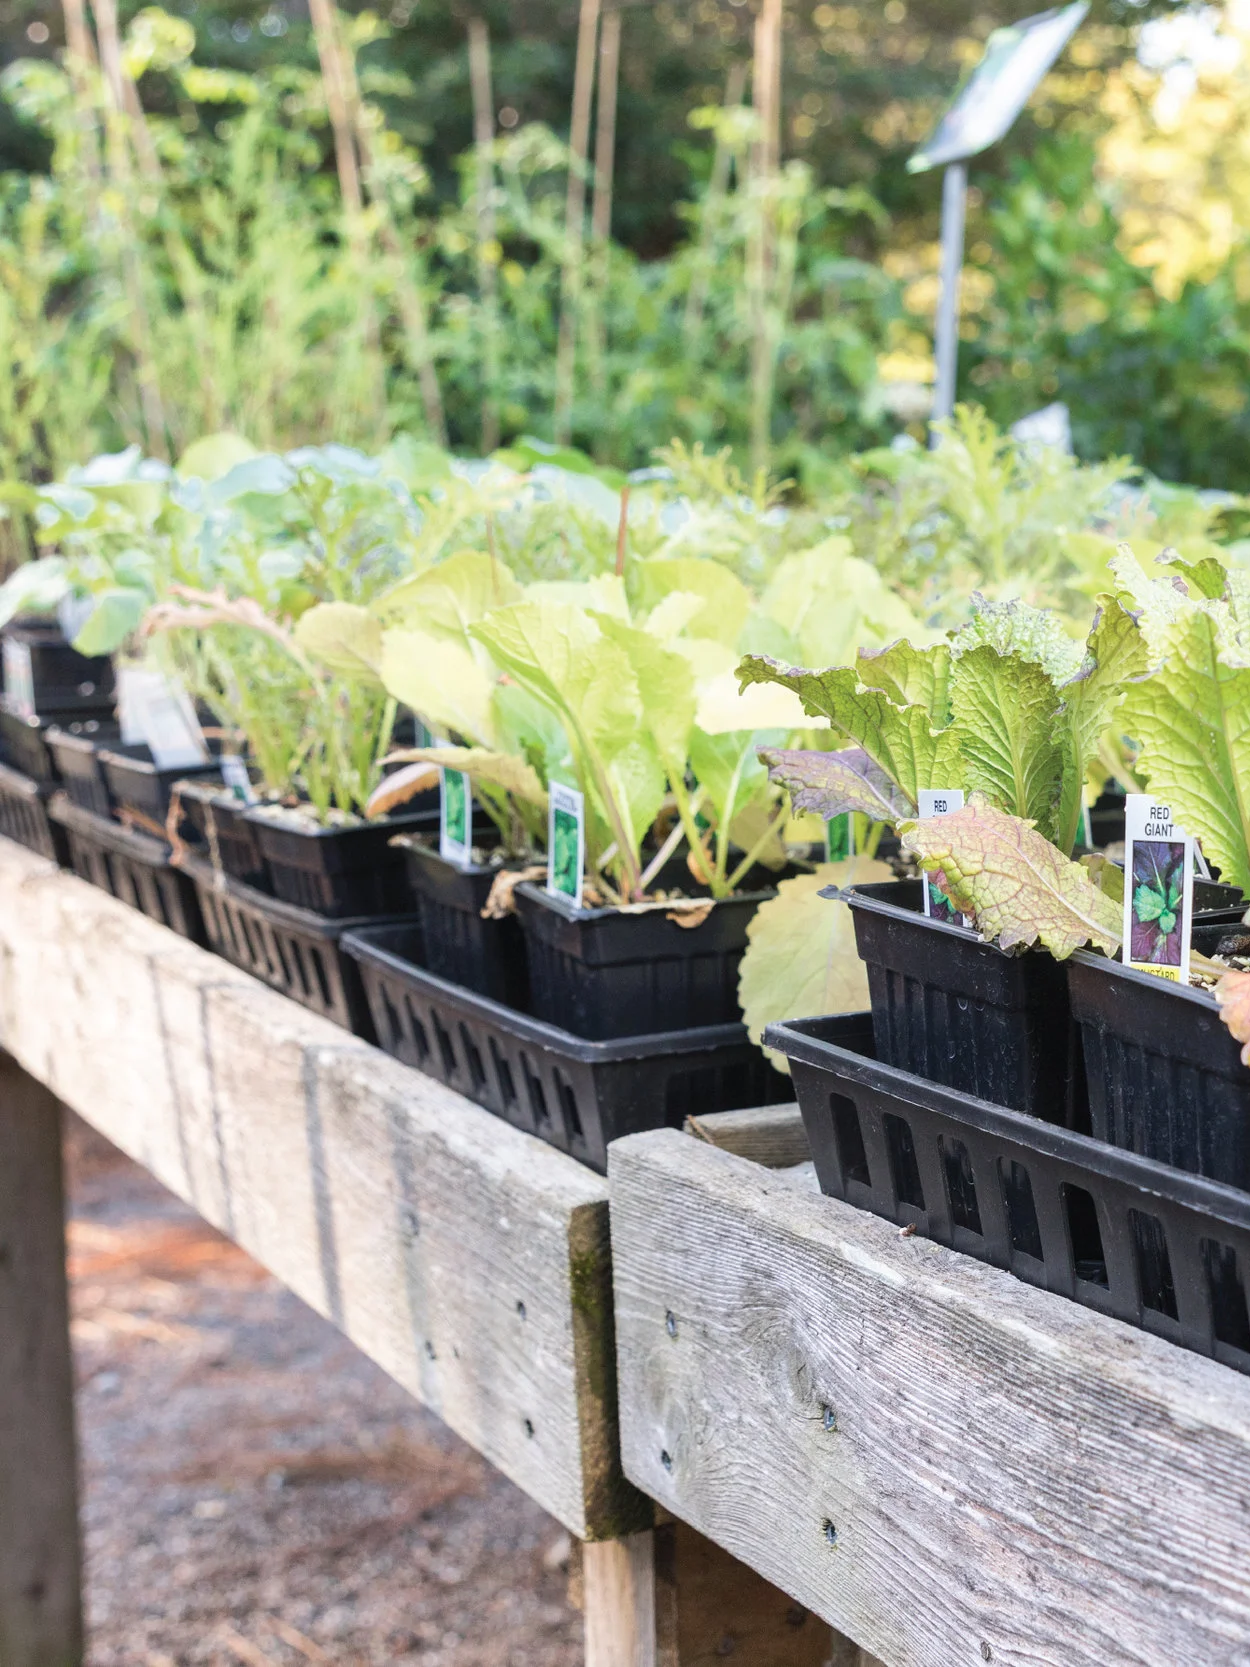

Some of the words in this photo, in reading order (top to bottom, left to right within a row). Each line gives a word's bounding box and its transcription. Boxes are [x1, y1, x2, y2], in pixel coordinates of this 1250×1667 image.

[933, 800, 947, 812] RED
[1150, 807, 1170, 820] RED
[1144, 823, 1174, 837] GIANT
